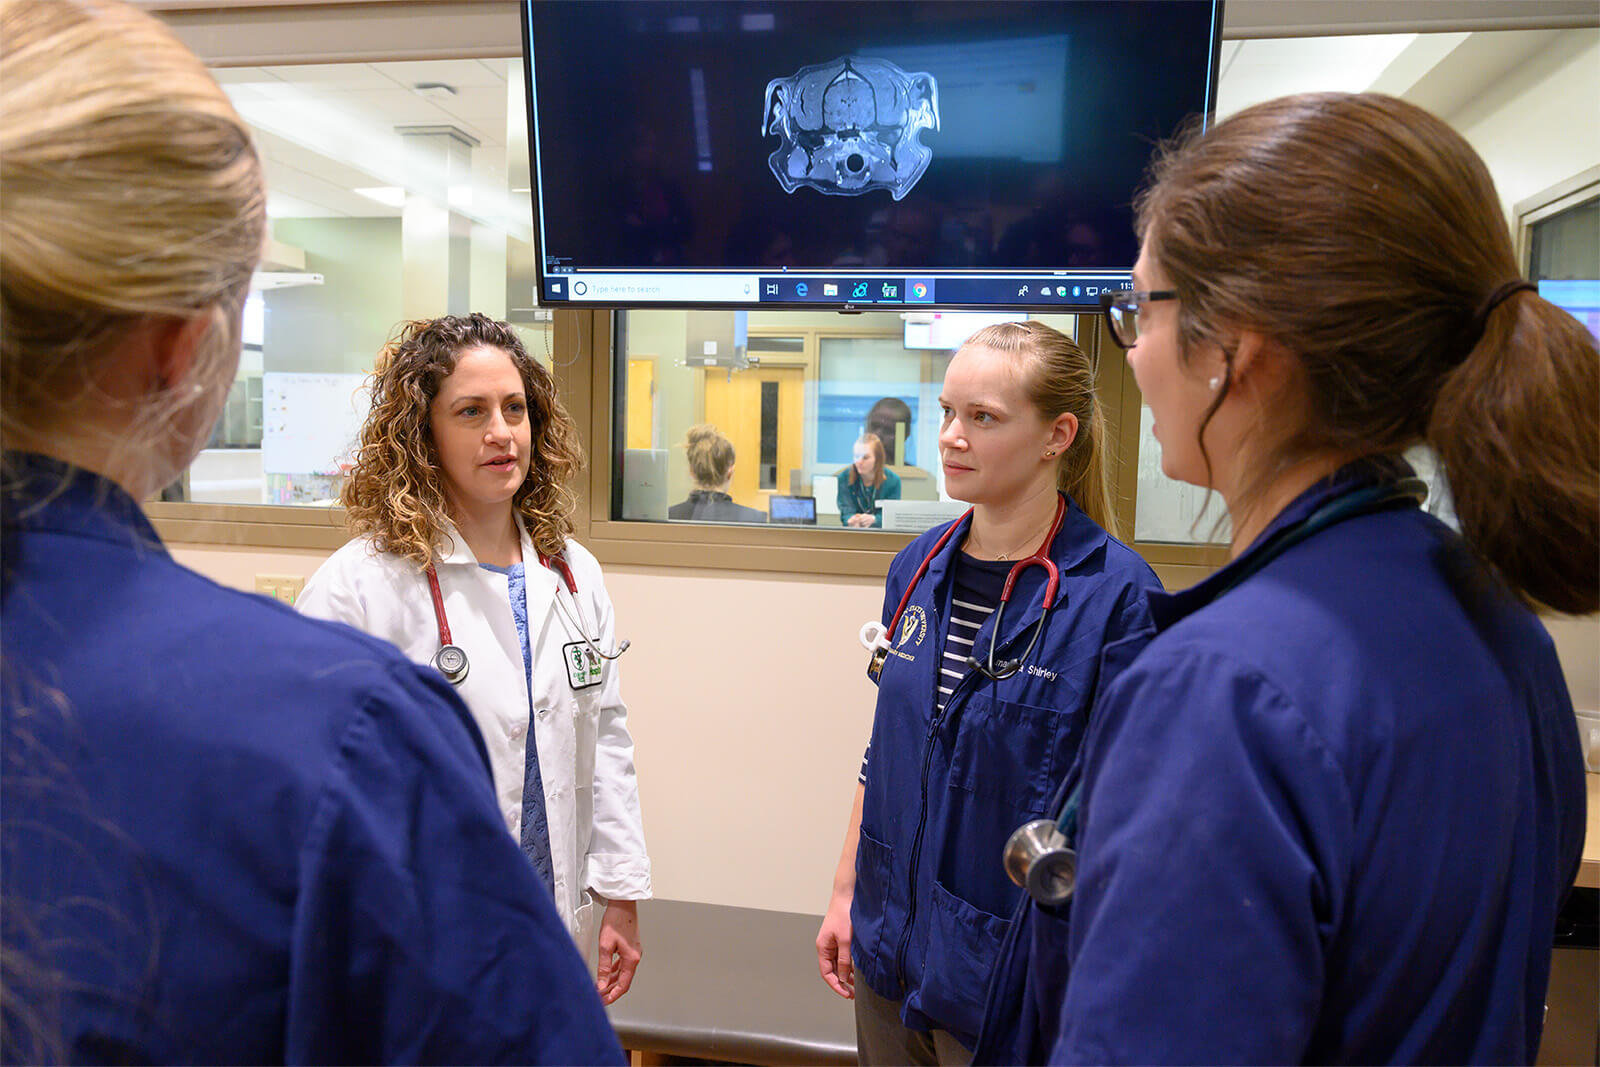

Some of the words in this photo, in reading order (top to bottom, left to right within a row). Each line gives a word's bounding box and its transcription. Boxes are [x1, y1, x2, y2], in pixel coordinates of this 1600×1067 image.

[592, 285, 609, 294] Type
[1120, 282, 1135, 290] 11:1
[1027, 664, 1058, 682] Shirley
